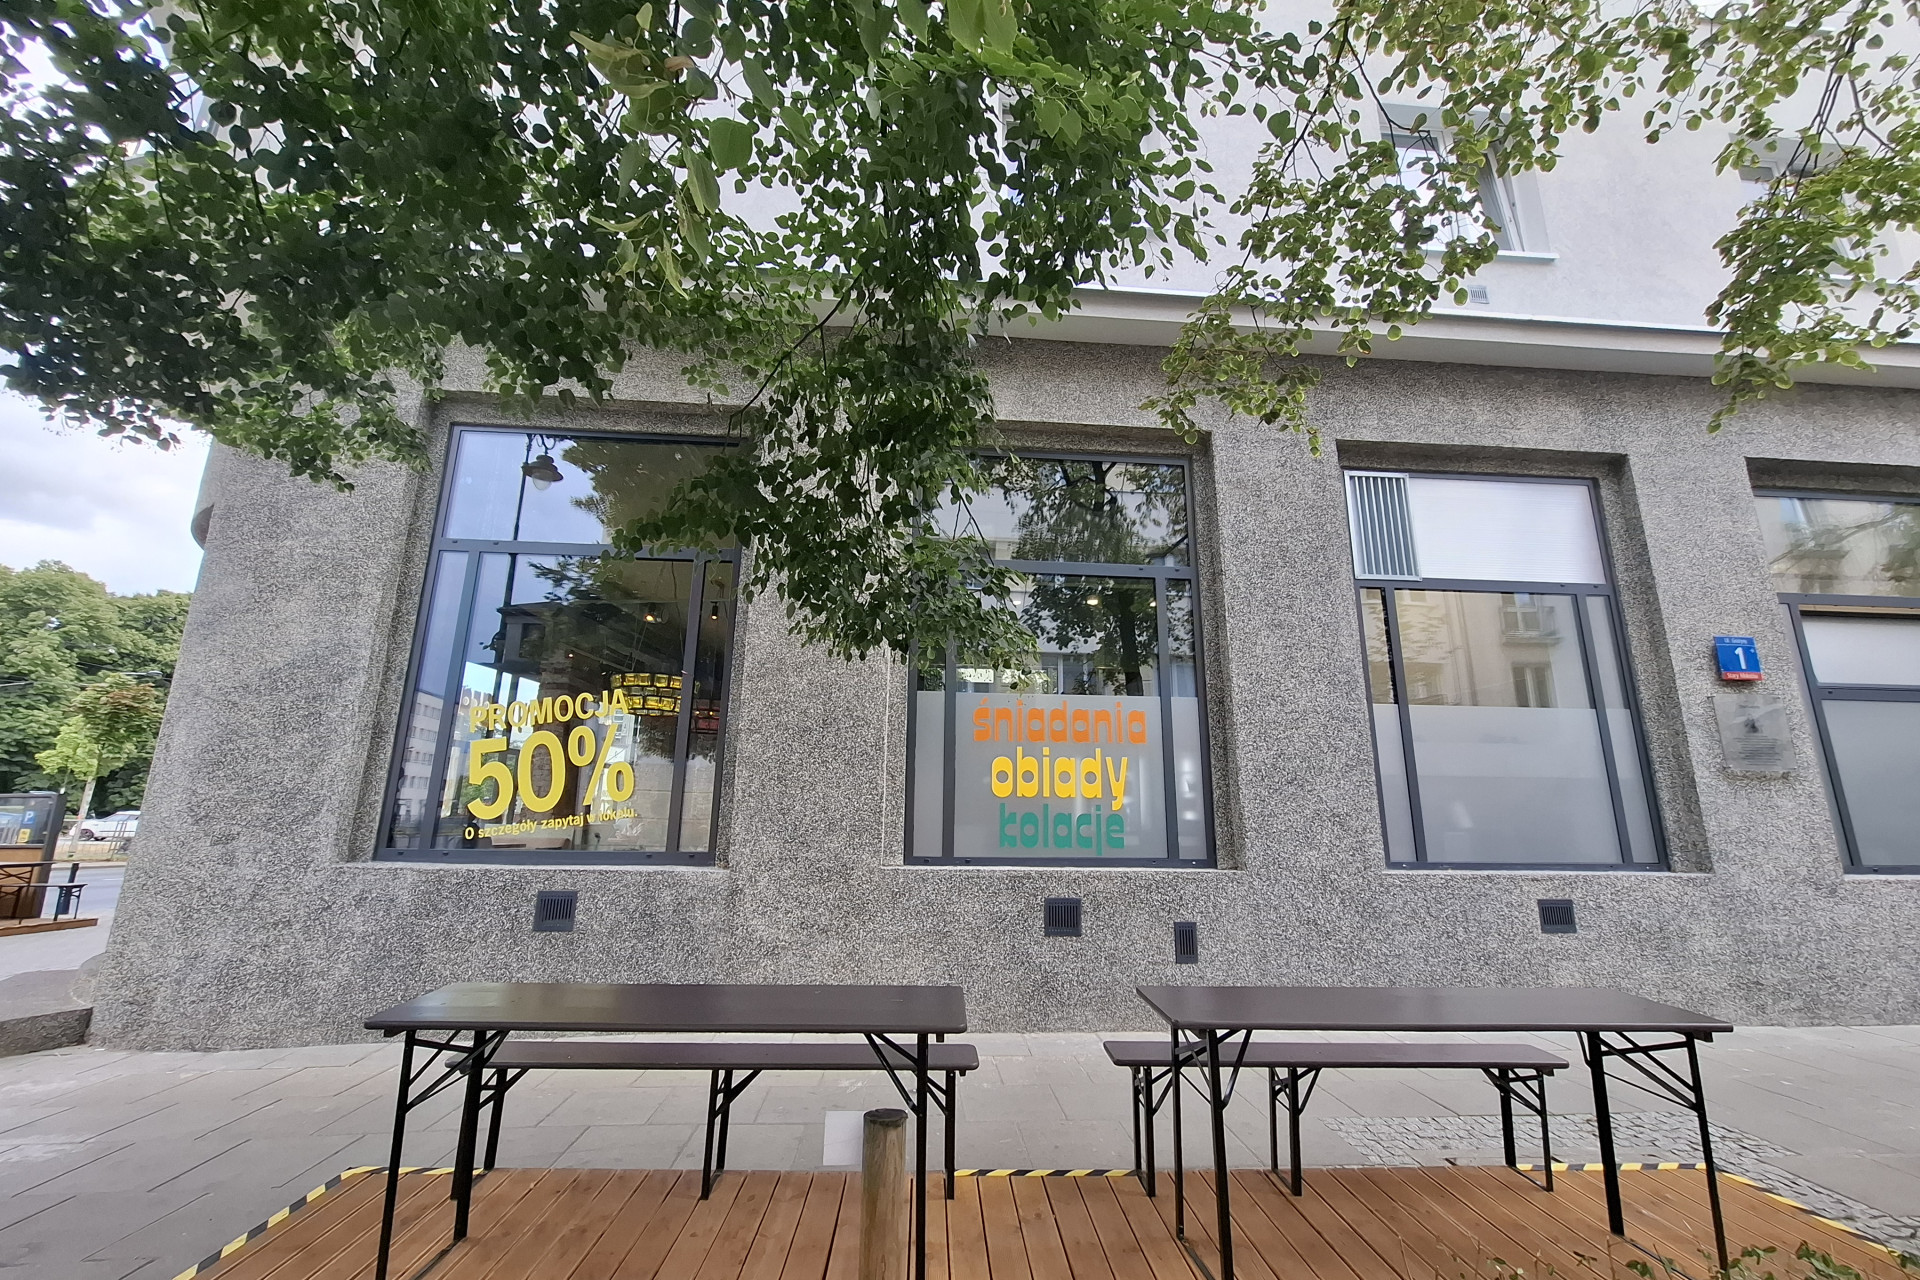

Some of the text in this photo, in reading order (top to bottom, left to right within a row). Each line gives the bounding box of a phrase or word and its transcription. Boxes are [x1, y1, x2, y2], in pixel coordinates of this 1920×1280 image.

[1734, 646, 1747, 670] 1
[469, 689, 629, 733] PROMOCJA
[972, 697, 1147, 744] śniadania
[467, 723, 635, 820] 50%
[991, 746, 1128, 811] obiady
[464, 827, 475, 840] O
[478, 818, 538, 839] szczegóły
[541, 812, 584, 831] zapytaj
[586, 813, 596, 823] w
[999, 803, 1125, 856] kolacje
